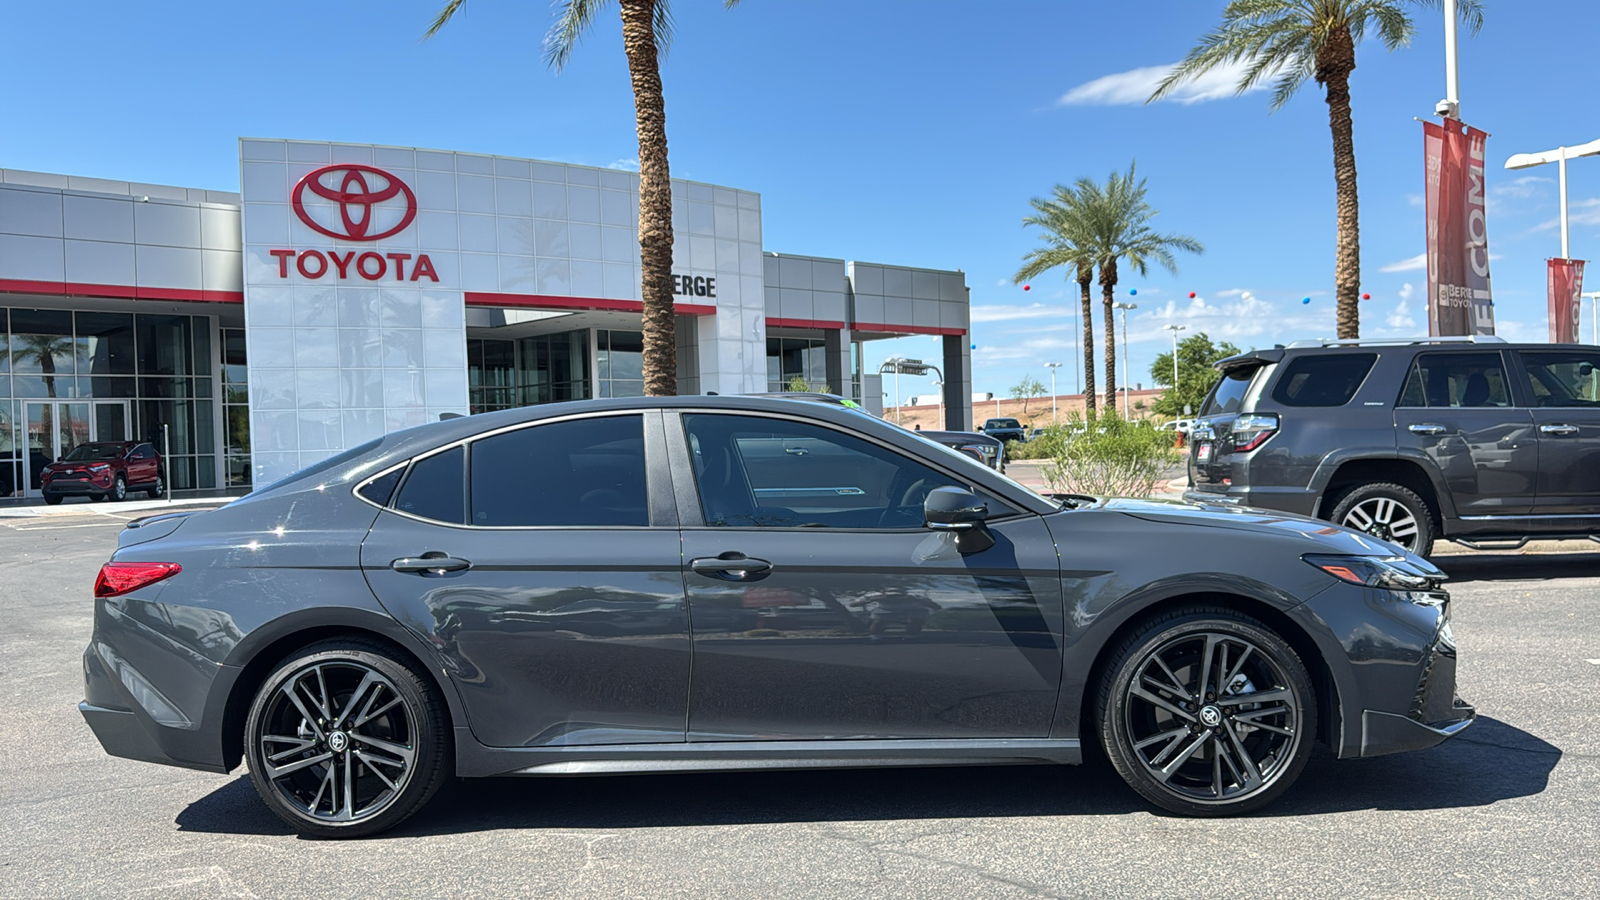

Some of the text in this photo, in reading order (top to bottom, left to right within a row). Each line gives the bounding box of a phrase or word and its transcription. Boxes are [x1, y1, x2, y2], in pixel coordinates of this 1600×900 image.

[1468, 135, 1494, 336] ELCOME
[269, 249, 440, 282] TOYOTA
[671, 274, 716, 298] ERGE
[1448, 284, 1472, 299] BERE
[1572, 263, 1584, 343] COME
